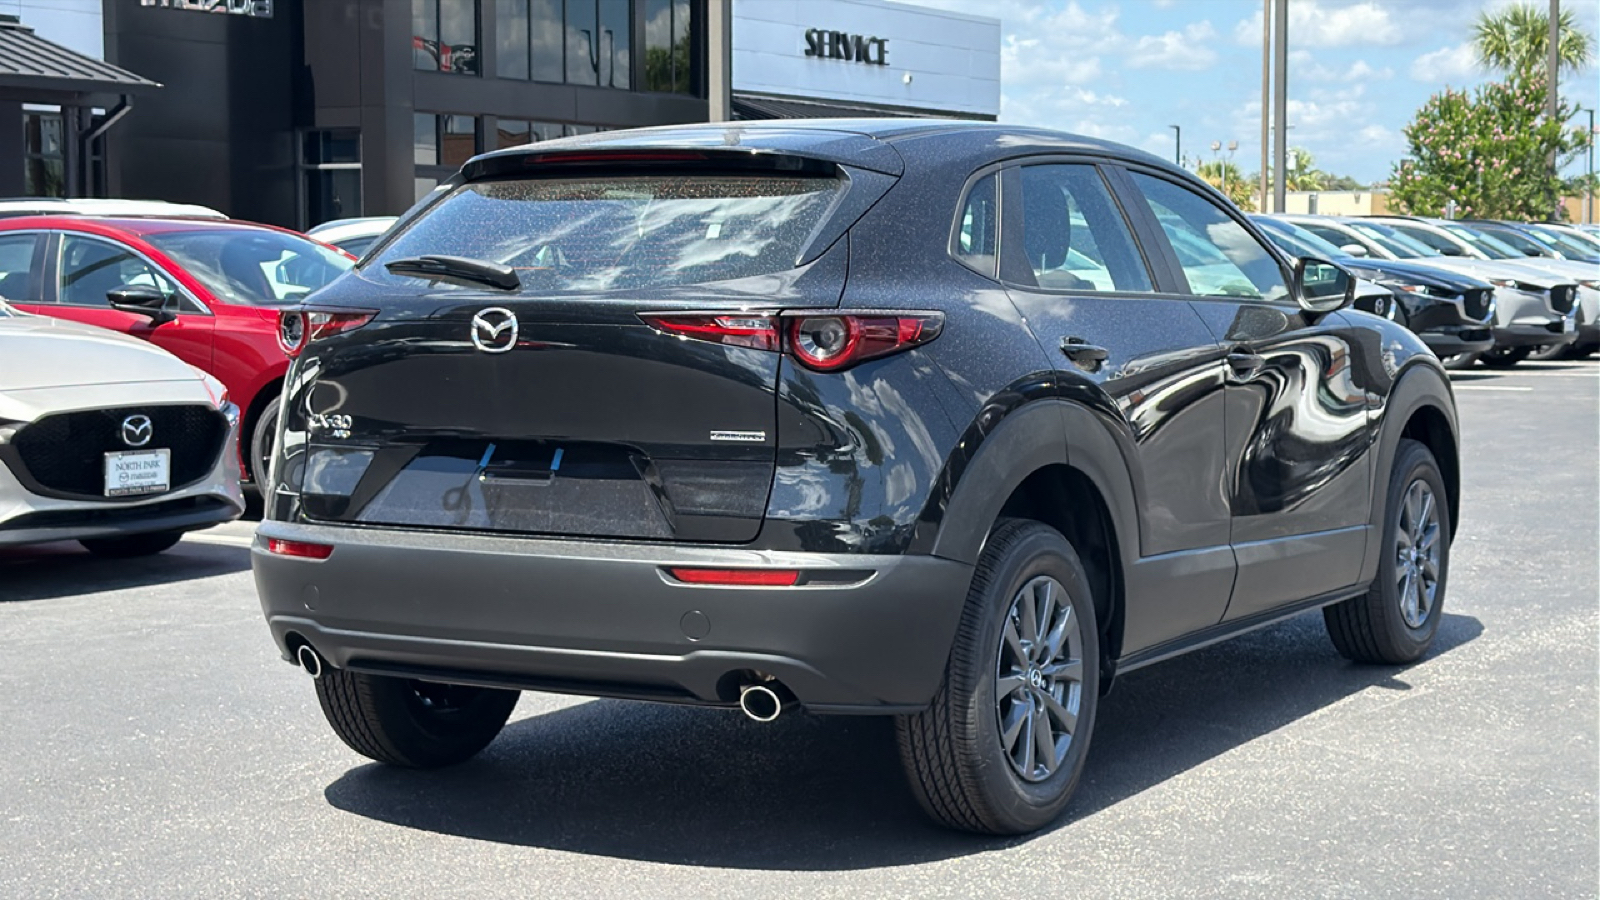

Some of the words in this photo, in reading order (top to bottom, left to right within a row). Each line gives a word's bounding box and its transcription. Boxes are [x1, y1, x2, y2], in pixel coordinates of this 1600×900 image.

[804, 27, 889, 66] SERVICE
[116, 462, 142, 470] NORTH
[144, 460, 160, 469] PARK
